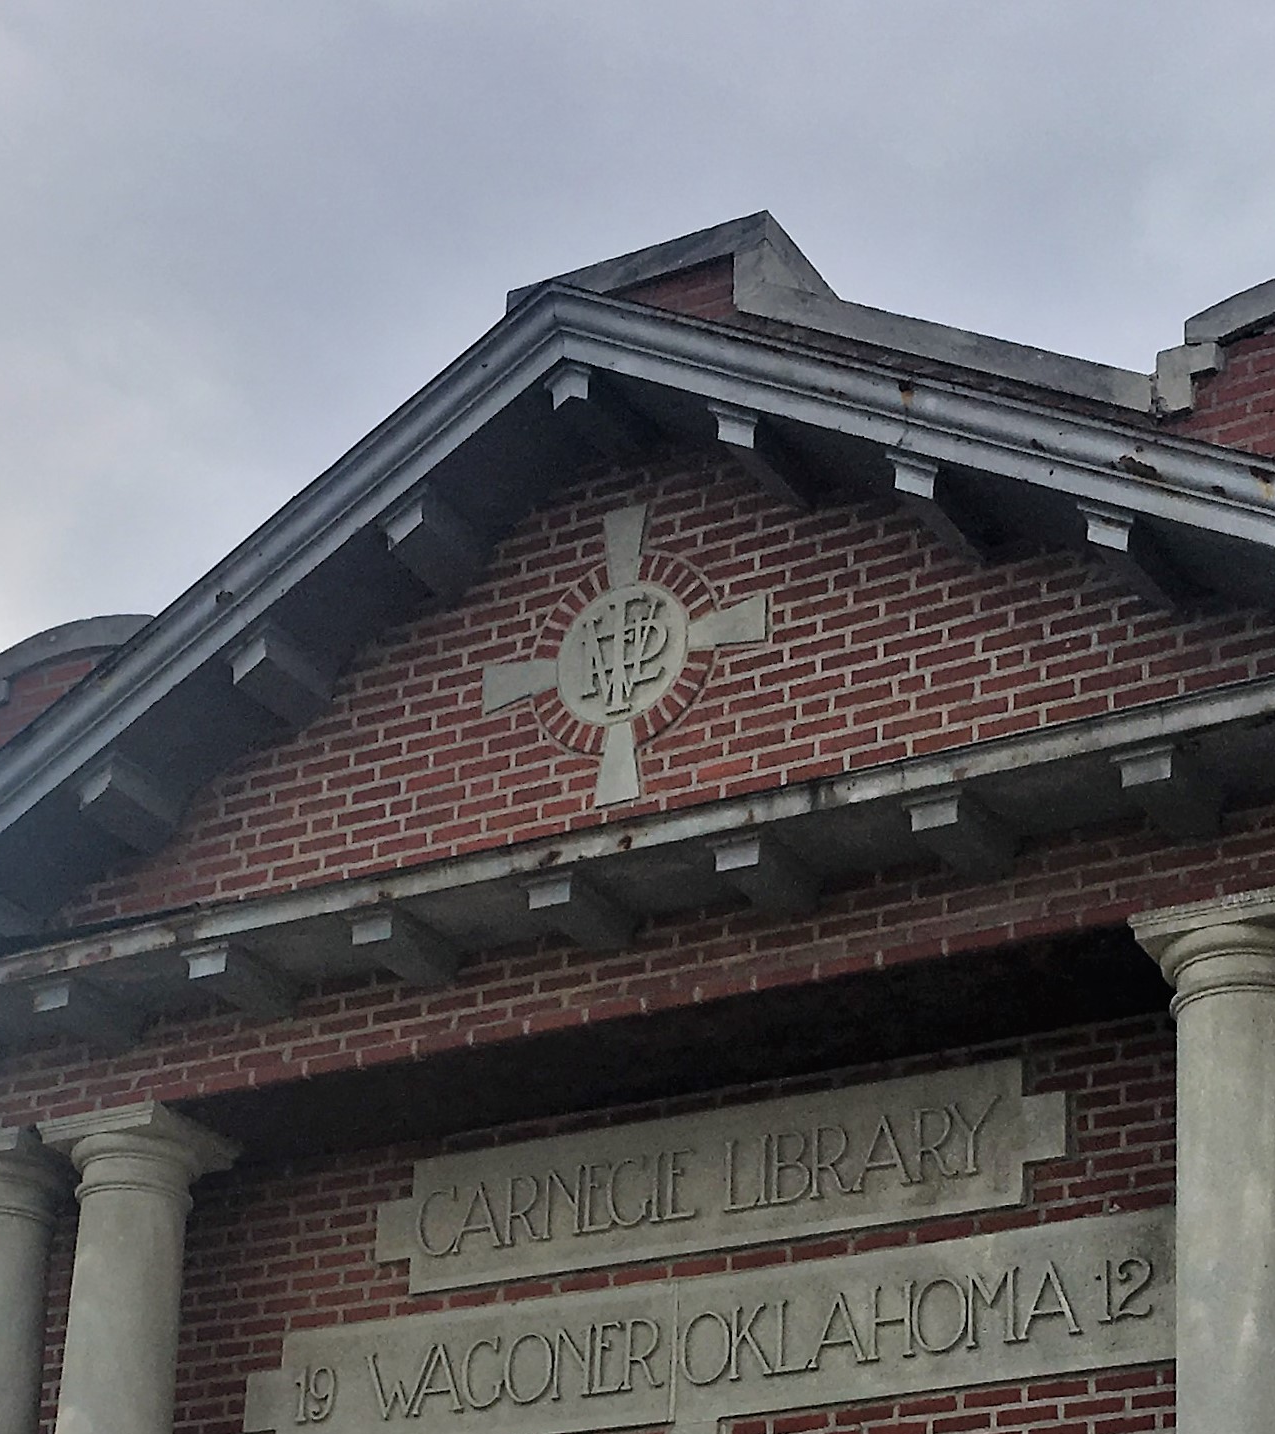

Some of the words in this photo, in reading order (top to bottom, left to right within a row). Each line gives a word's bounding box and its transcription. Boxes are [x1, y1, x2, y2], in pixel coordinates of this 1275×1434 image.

[415, 1147, 697, 1257] CARNEGIE
[723, 1094, 1003, 1213] LIBRARY
[294, 1363, 339, 1425] 19
[366, 1317, 665, 1422] WAGONER
[682, 1259, 1084, 1386] OKLAHOMA
[1096, 1257, 1155, 1325] 12
